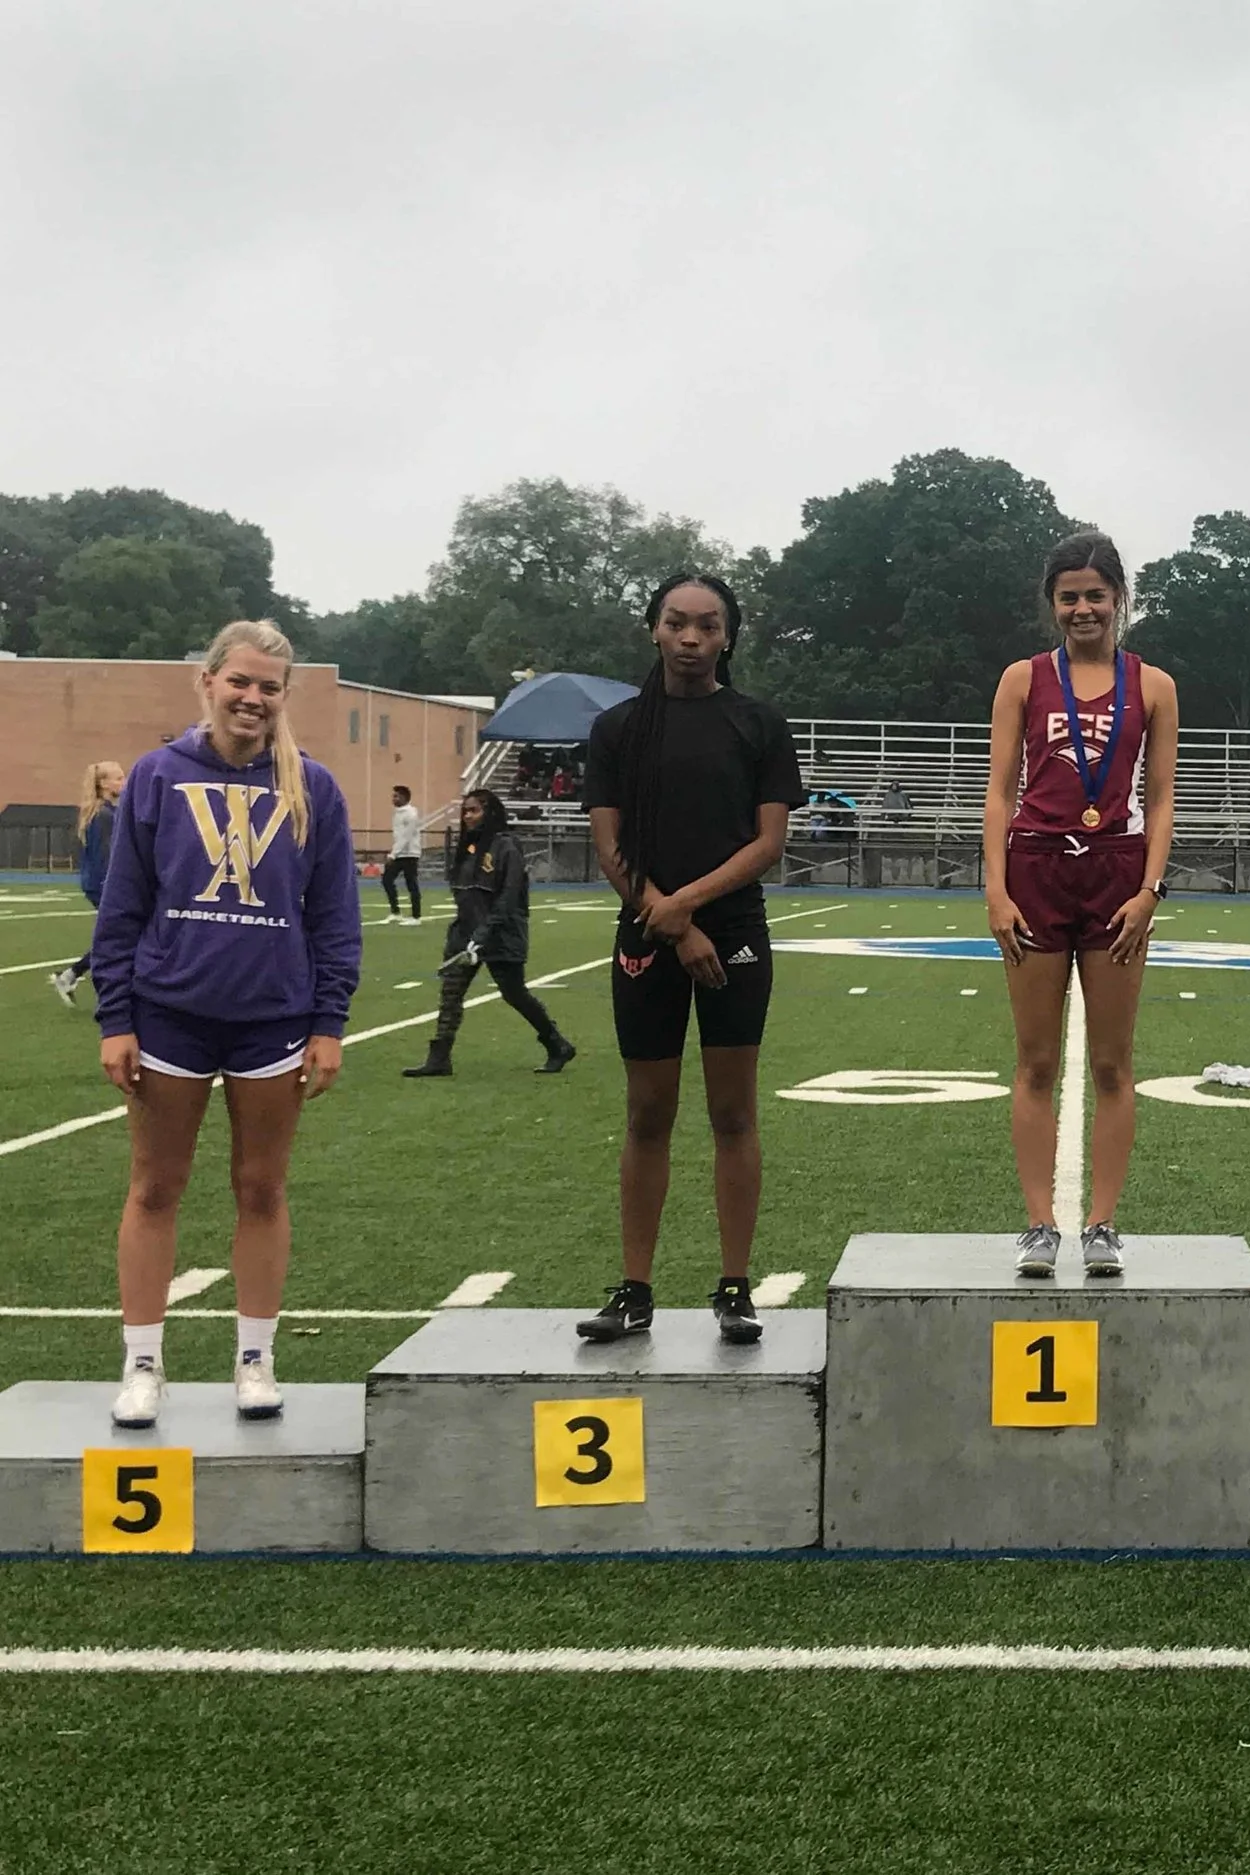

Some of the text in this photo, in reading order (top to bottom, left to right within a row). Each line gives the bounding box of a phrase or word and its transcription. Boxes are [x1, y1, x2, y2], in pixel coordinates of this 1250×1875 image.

[166, 908, 290, 928] BASKETBALL
[728, 956, 758, 964] adidas
[1026, 1336, 1067, 1403] 1
[564, 1415, 613, 1485] 3
[112, 1466, 162, 1533] 5
